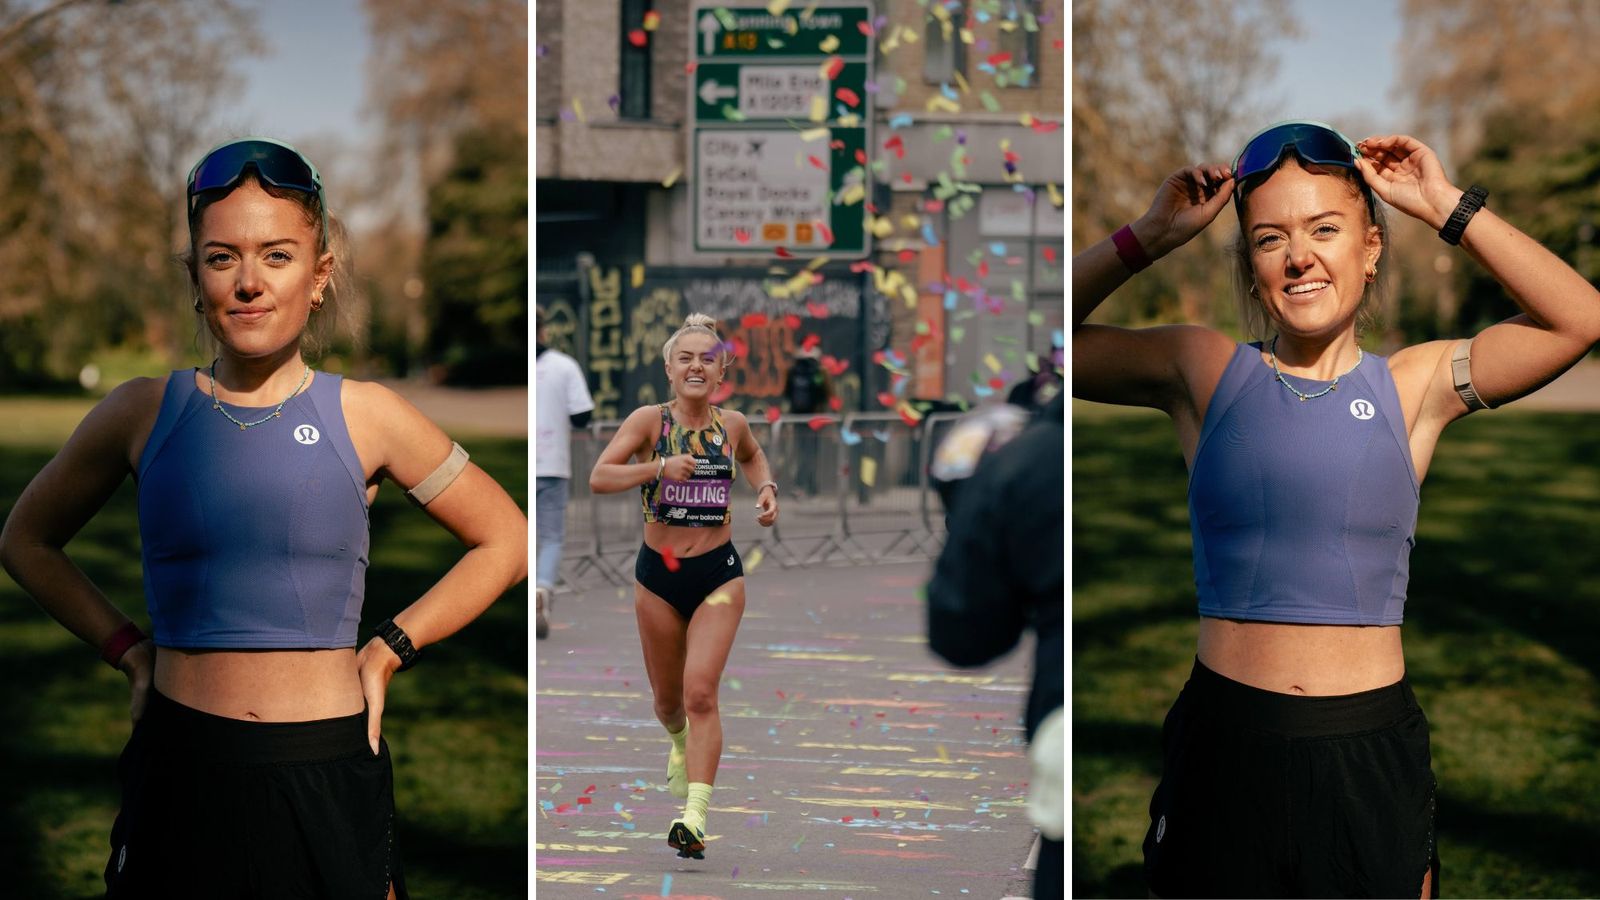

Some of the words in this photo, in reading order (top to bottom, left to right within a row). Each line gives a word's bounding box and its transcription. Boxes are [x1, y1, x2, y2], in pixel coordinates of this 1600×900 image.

[747, 74, 781, 88] Mile
[789, 74, 822, 88] End
[705, 140, 739, 157] City
[705, 187, 752, 202] Royal
[759, 186, 811, 200] Docks
[705, 206, 764, 222] Canary
[771, 206, 823, 219] Wharf
[664, 484, 726, 504] CULLING
